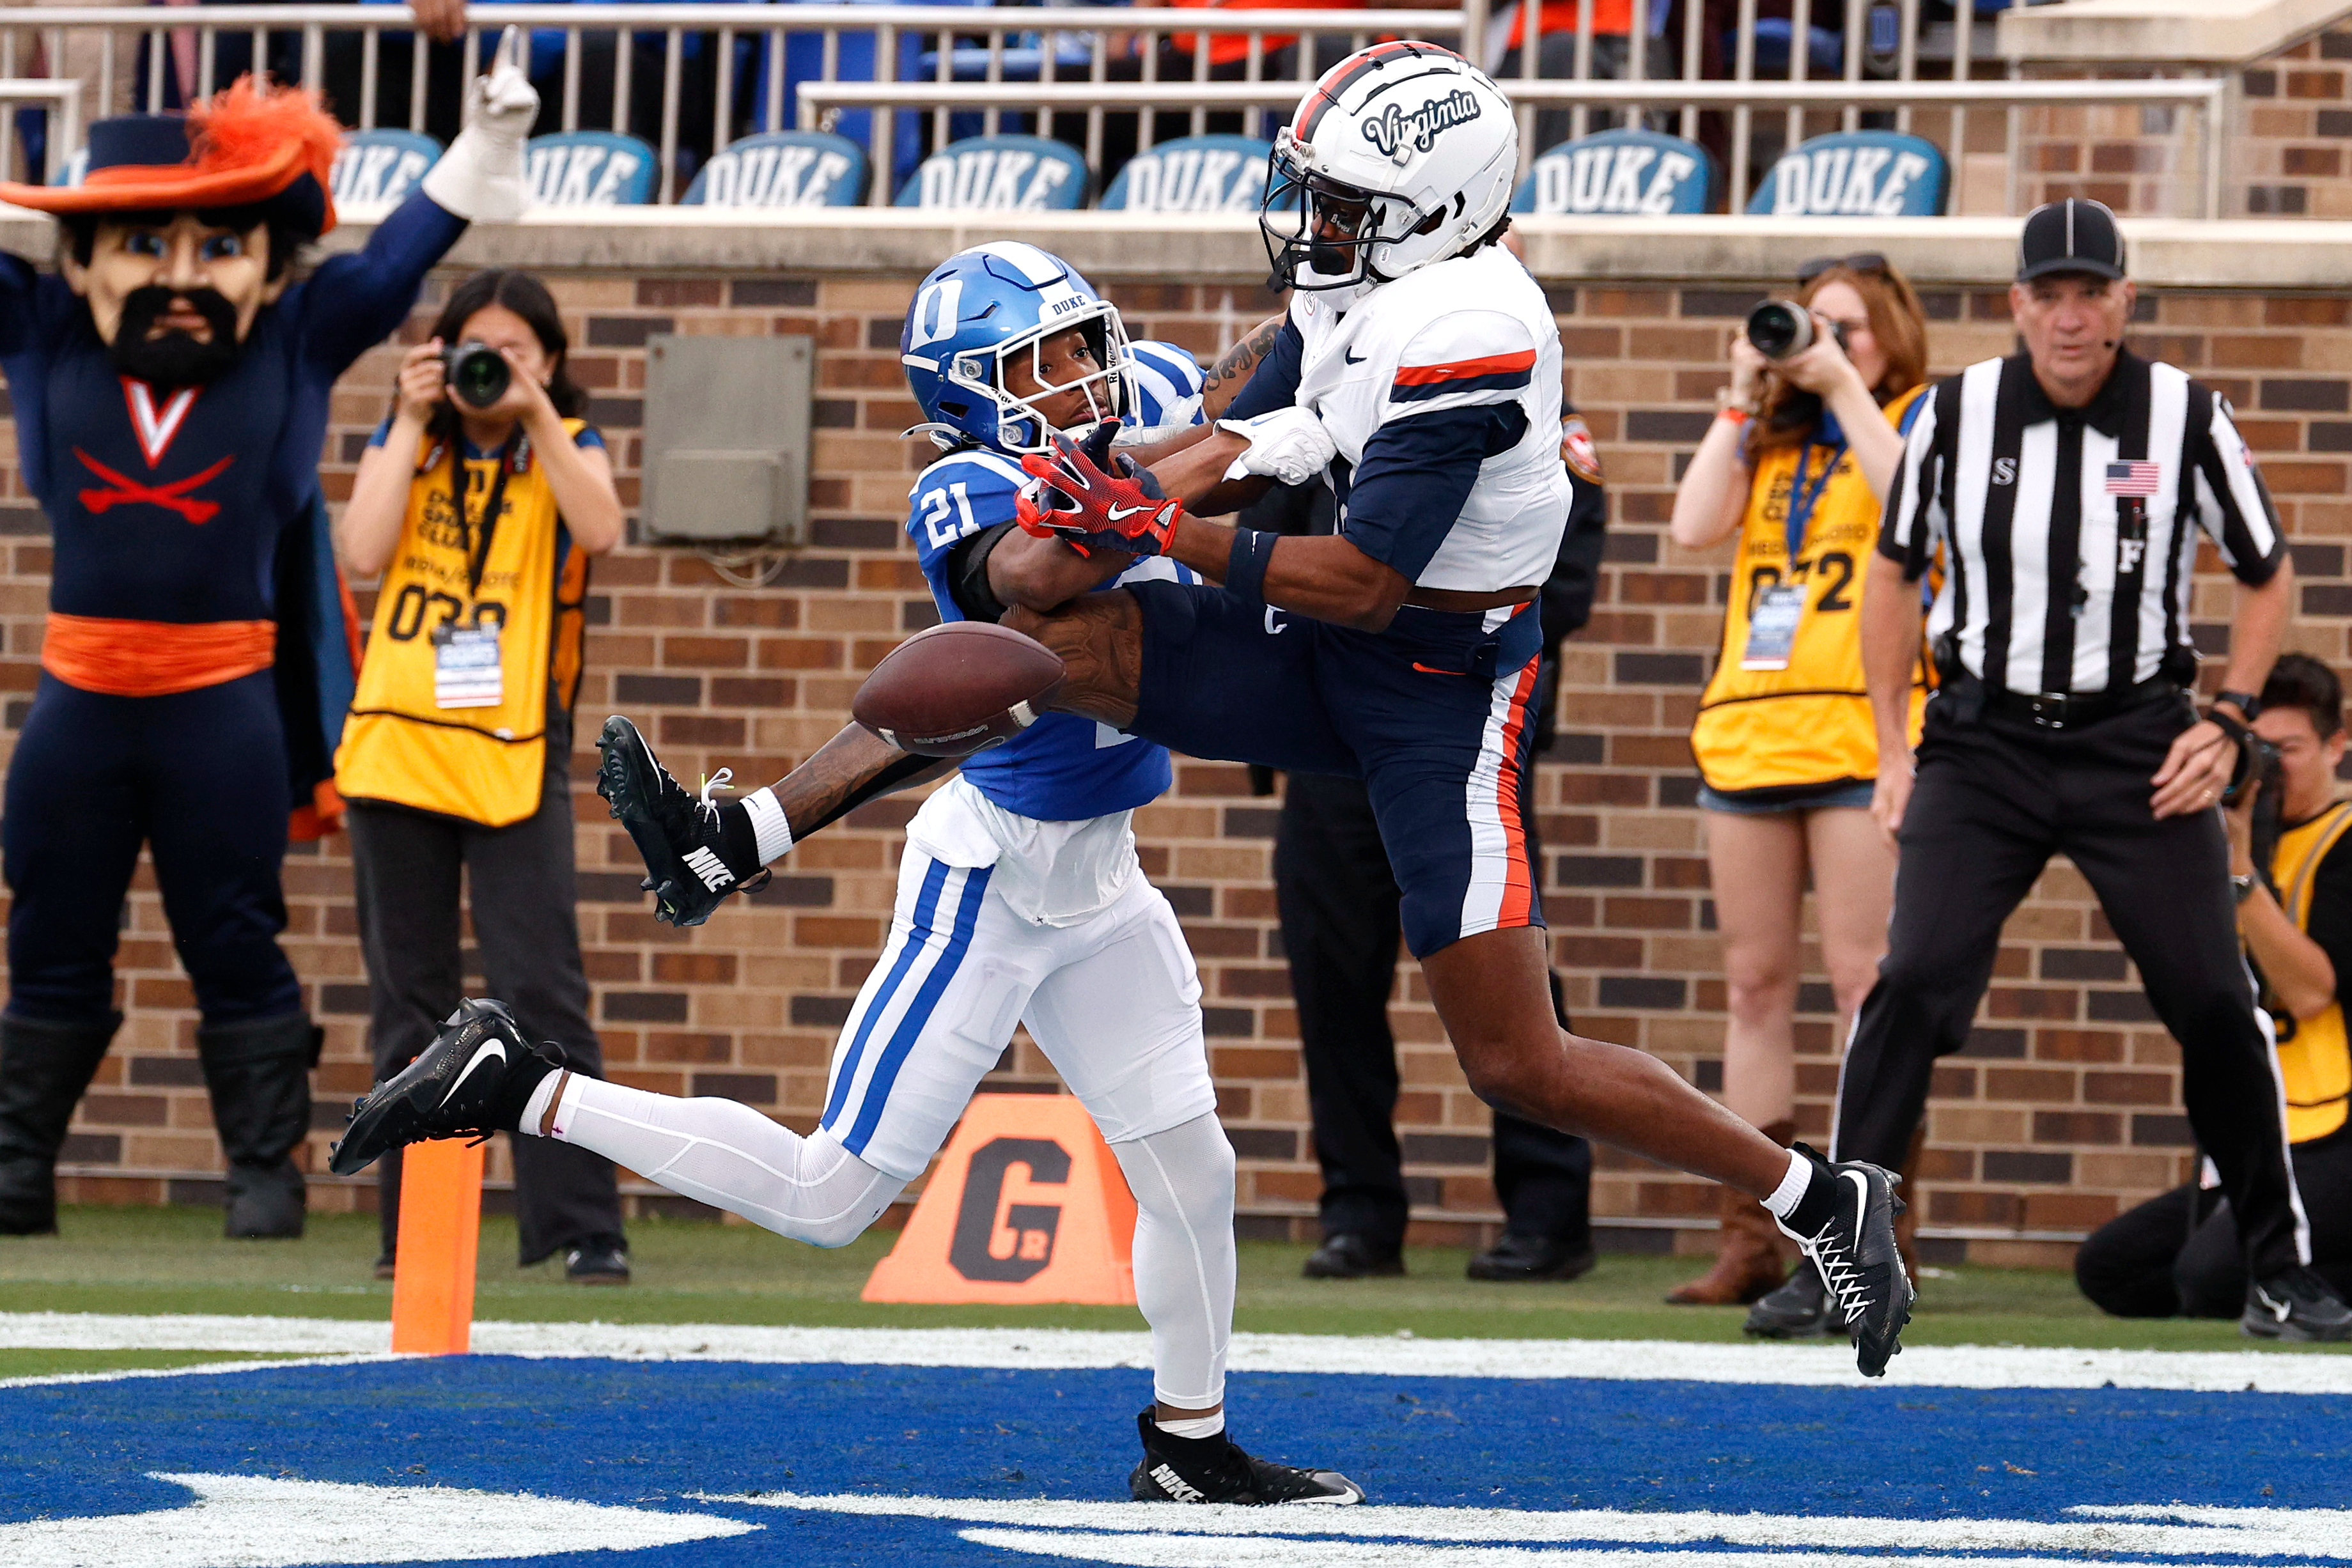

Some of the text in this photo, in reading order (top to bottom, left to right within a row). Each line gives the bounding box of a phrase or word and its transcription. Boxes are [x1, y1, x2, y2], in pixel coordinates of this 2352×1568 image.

[1362, 90, 1480, 155] Virginia
[329, 143, 428, 201] UKE
[528, 145, 640, 203] UKE
[705, 146, 852, 205] DUKE
[919, 149, 1071, 208] DUKE
[1125, 150, 1268, 210] DUKE
[1534, 146, 1696, 213] DUKE
[1772, 147, 1928, 216] DUKE
[909, 279, 963, 352] D
[1052, 295, 1086, 316] DUKE
[120, 374, 205, 470] V
[1991, 457, 2016, 485] S
[921, 481, 981, 550] 21
[2118, 538, 2146, 573] F
[1747, 552, 1853, 623] 02
[681, 845, 736, 893] NIKE
[949, 1137, 1072, 1282] G
[1149, 1463, 1204, 1503] NIKE
